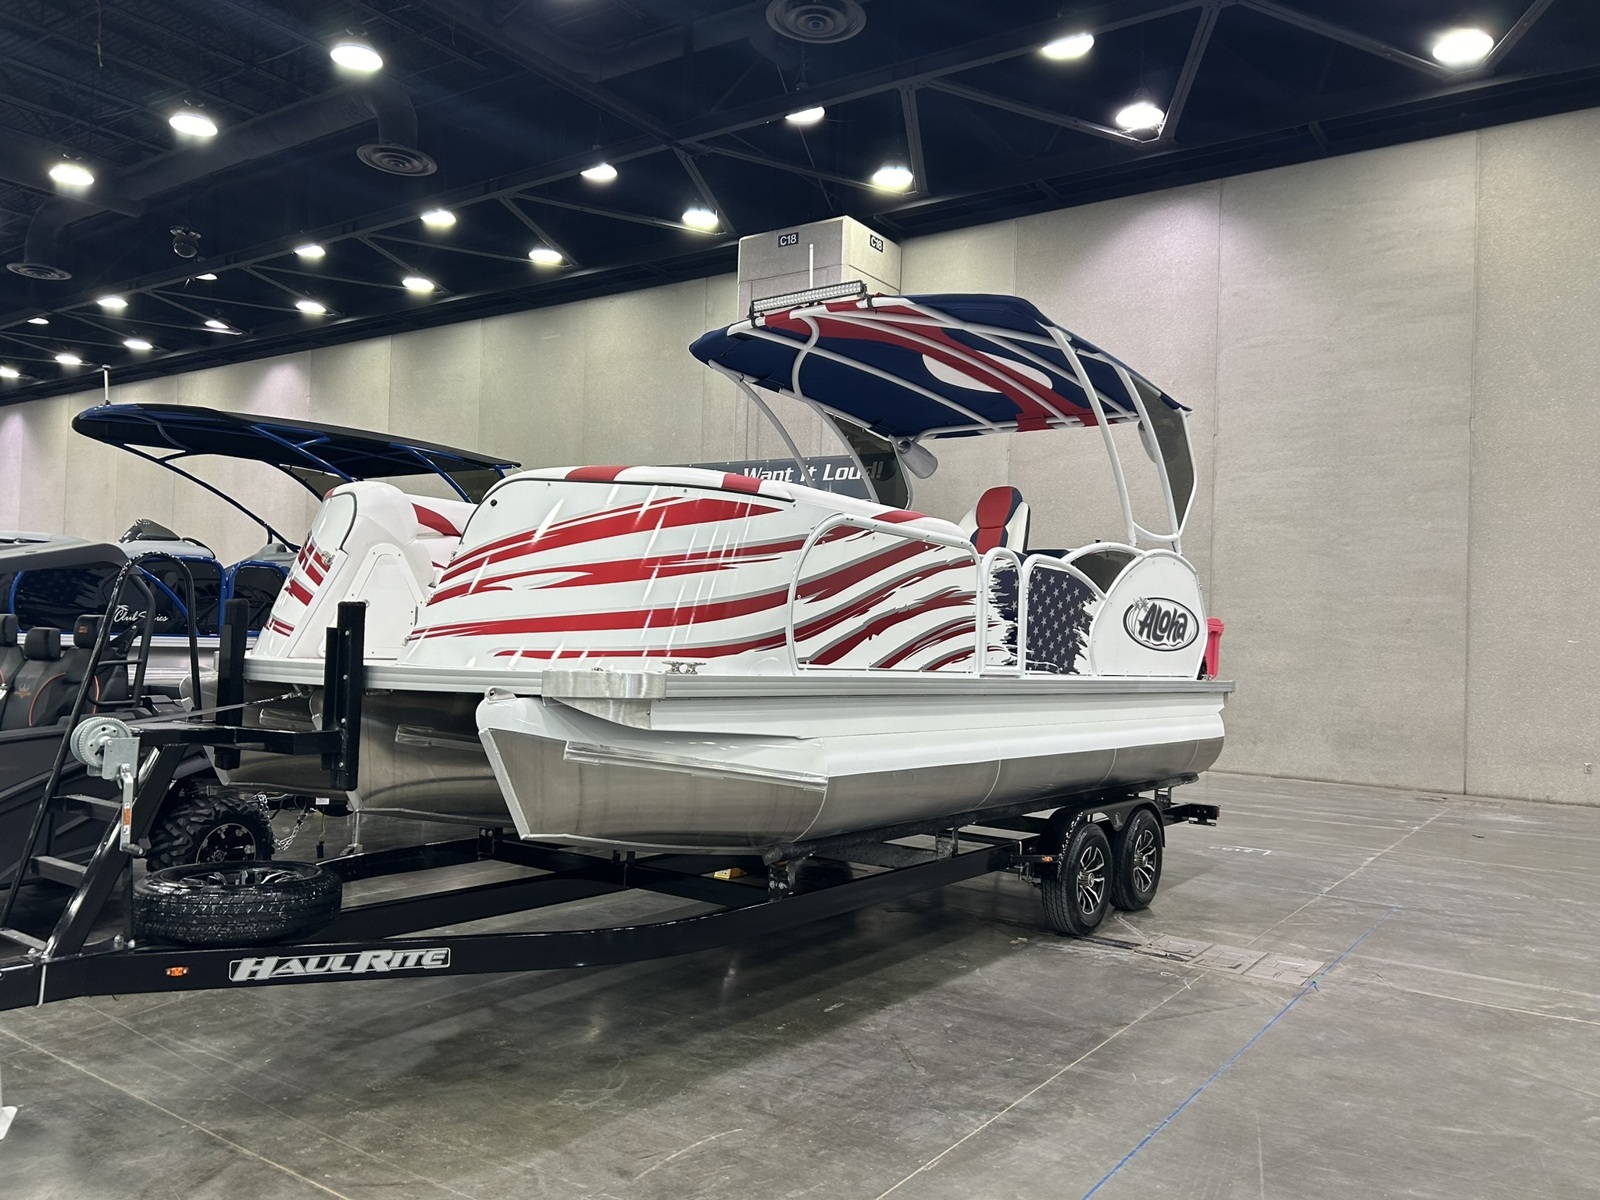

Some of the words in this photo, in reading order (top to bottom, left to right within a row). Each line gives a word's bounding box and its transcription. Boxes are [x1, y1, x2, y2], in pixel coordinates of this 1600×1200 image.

[780, 234, 797, 246] C18
[870, 237, 882, 251] C18
[743, 466, 794, 482] Want
